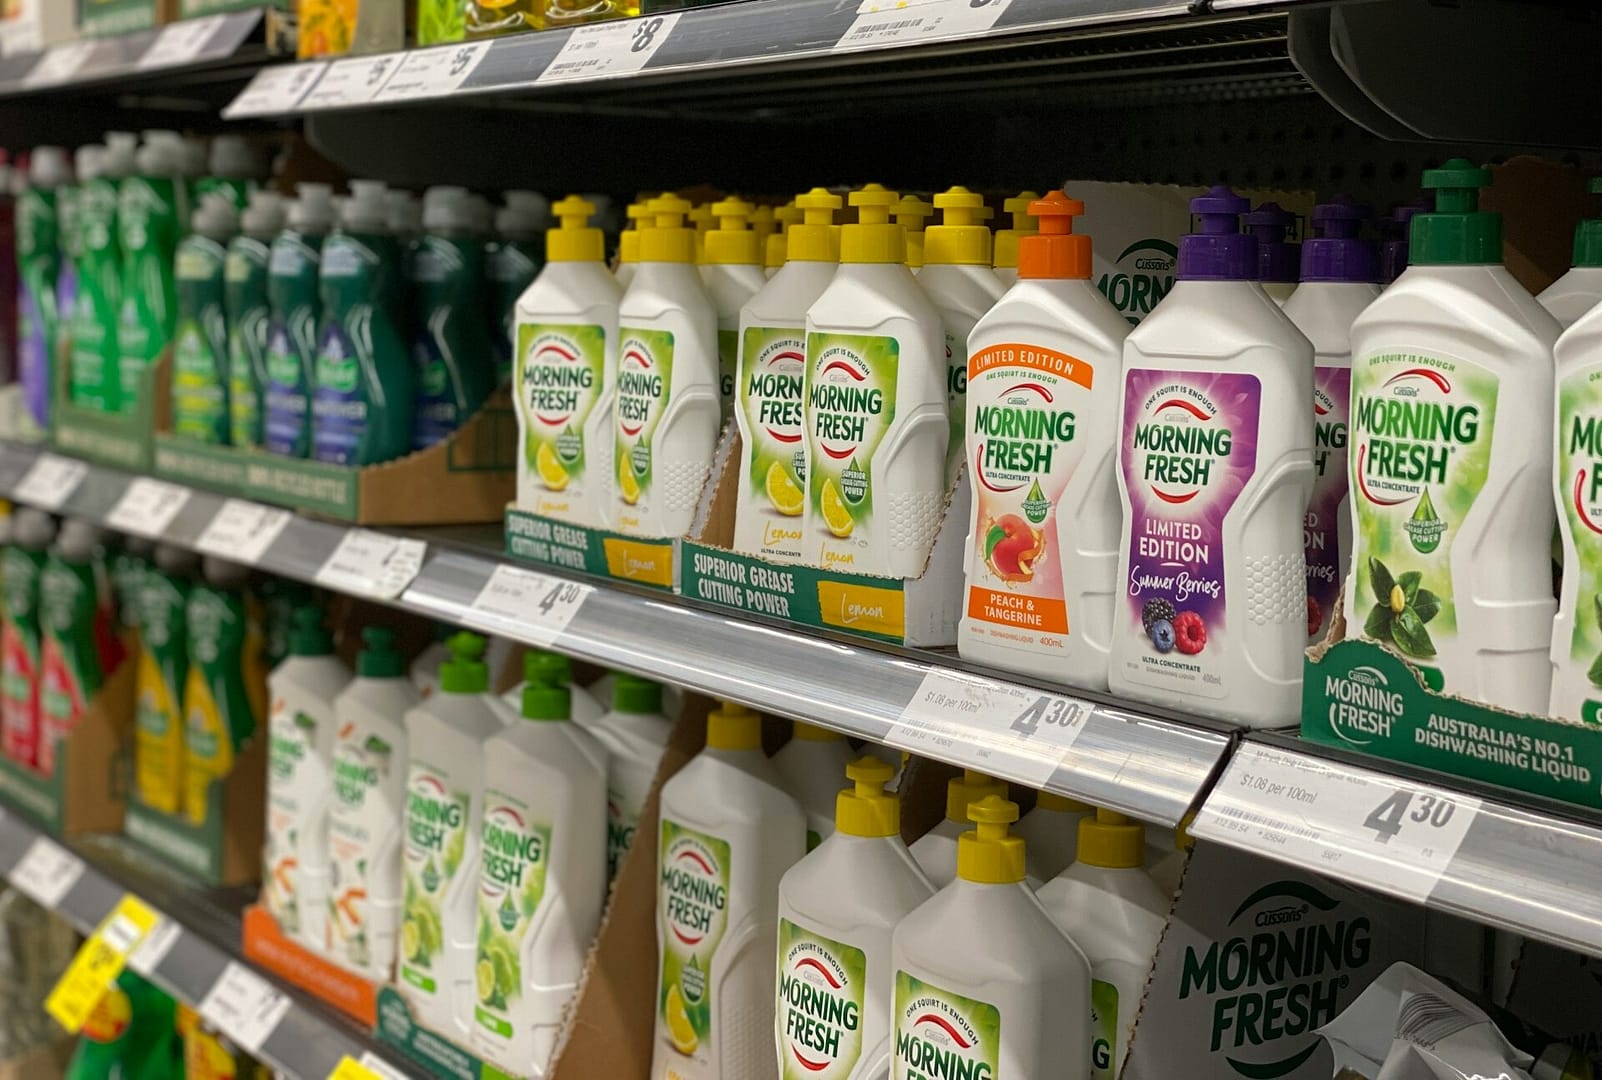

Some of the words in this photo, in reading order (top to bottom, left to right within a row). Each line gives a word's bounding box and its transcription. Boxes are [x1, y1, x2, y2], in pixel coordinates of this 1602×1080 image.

[632, 18, 663, 52] $8
[522, 366, 593, 388] MORNING
[848, 351, 870, 375] ENOUGH
[976, 350, 1015, 370] LIMITED
[1020, 351, 1074, 375] EDITION
[996, 370, 1018, 380] SQUIRT
[1028, 371, 1058, 385] ENOUGH
[1382, 354, 1407, 364] SQUIRT
[1409, 355, 1416, 363] IS
[1418, 356, 1456, 372] ENOUGH
[530, 389, 578, 411] FRESH
[749, 374, 803, 400] MORN
[809, 384, 882, 415] MORNING
[1145, 394, 1156, 410] ONE
[1156, 385, 1179, 398] SQUIRT
[1188, 389, 1217, 415] ENOUGH
[1314, 389, 1334, 410] OUGH
[618, 397, 651, 421] FRESH
[760, 401, 802, 425] FRES
[974, 405, 1075, 442] MORNING
[1356, 397, 1479, 444] MORNING
[816, 412, 865, 442] FRESH
[1134, 423, 1232, 456] MORNING
[984, 439, 1053, 474] FRESH
[1144, 454, 1210, 485] FRESH
[1367, 439, 1449, 484] FRESH
[1382, 482, 1420, 494] CONCENTRATE
[508, 514, 552, 541] SUPERIOR
[552, 525, 588, 550] GREASE
[1146, 518, 1201, 540] LIMITED
[1411, 533, 1439, 543] POWER
[511, 536, 549, 561] CUTTING
[551, 547, 586, 570] POWER
[820, 542, 854, 568] Lemon
[1139, 536, 1209, 564] EDITION
[694, 553, 747, 584] SUPERIOR
[749, 566, 795, 594] GREASE
[1130, 565, 1175, 596] Summer
[1175, 571, 1221, 602] Berries
[699, 578, 743, 607] CUTTING
[746, 591, 790, 617] POWER
[841, 593, 884, 624] Lemon
[990, 593, 1023, 610] PEACH
[1026, 599, 1035, 611] &
[984, 605, 1042, 626] TANGERINE
[1142, 656, 1158, 665] ULTRA
[1159, 659, 1201, 673] CONCENTRATE
[943, 698, 957, 709] per
[1325, 675, 1404, 716] MORNING
[1338, 704, 1391, 738] FRESH
[1427, 714, 1531, 751] AUSTRALIA'S
[1534, 739, 1574, 762] NO.1
[1415, 728, 1528, 769] DISHWASHING
[1532, 755, 1591, 782] LIQUID
[1240, 773, 1268, 790] $1.08
[1267, 782, 1286, 794] per
[1287, 786, 1318, 804] 100ml
[661, 864, 725, 910] MORNING
[667, 895, 711, 934] FRESH
[824, 951, 849, 986] ENOUGH
[1179, 916, 1372, 1000] MORNING
[779, 971, 858, 1031] MORNING
[786, 1008, 841, 1058] FRESH
[906, 1003, 917, 1018] ONE
[917, 999, 940, 1009] SQUIRT
[941, 1002, 948, 1012] IS
[949, 1008, 979, 1046] ENOUGH
[896, 1027, 992, 1080] MORNING
